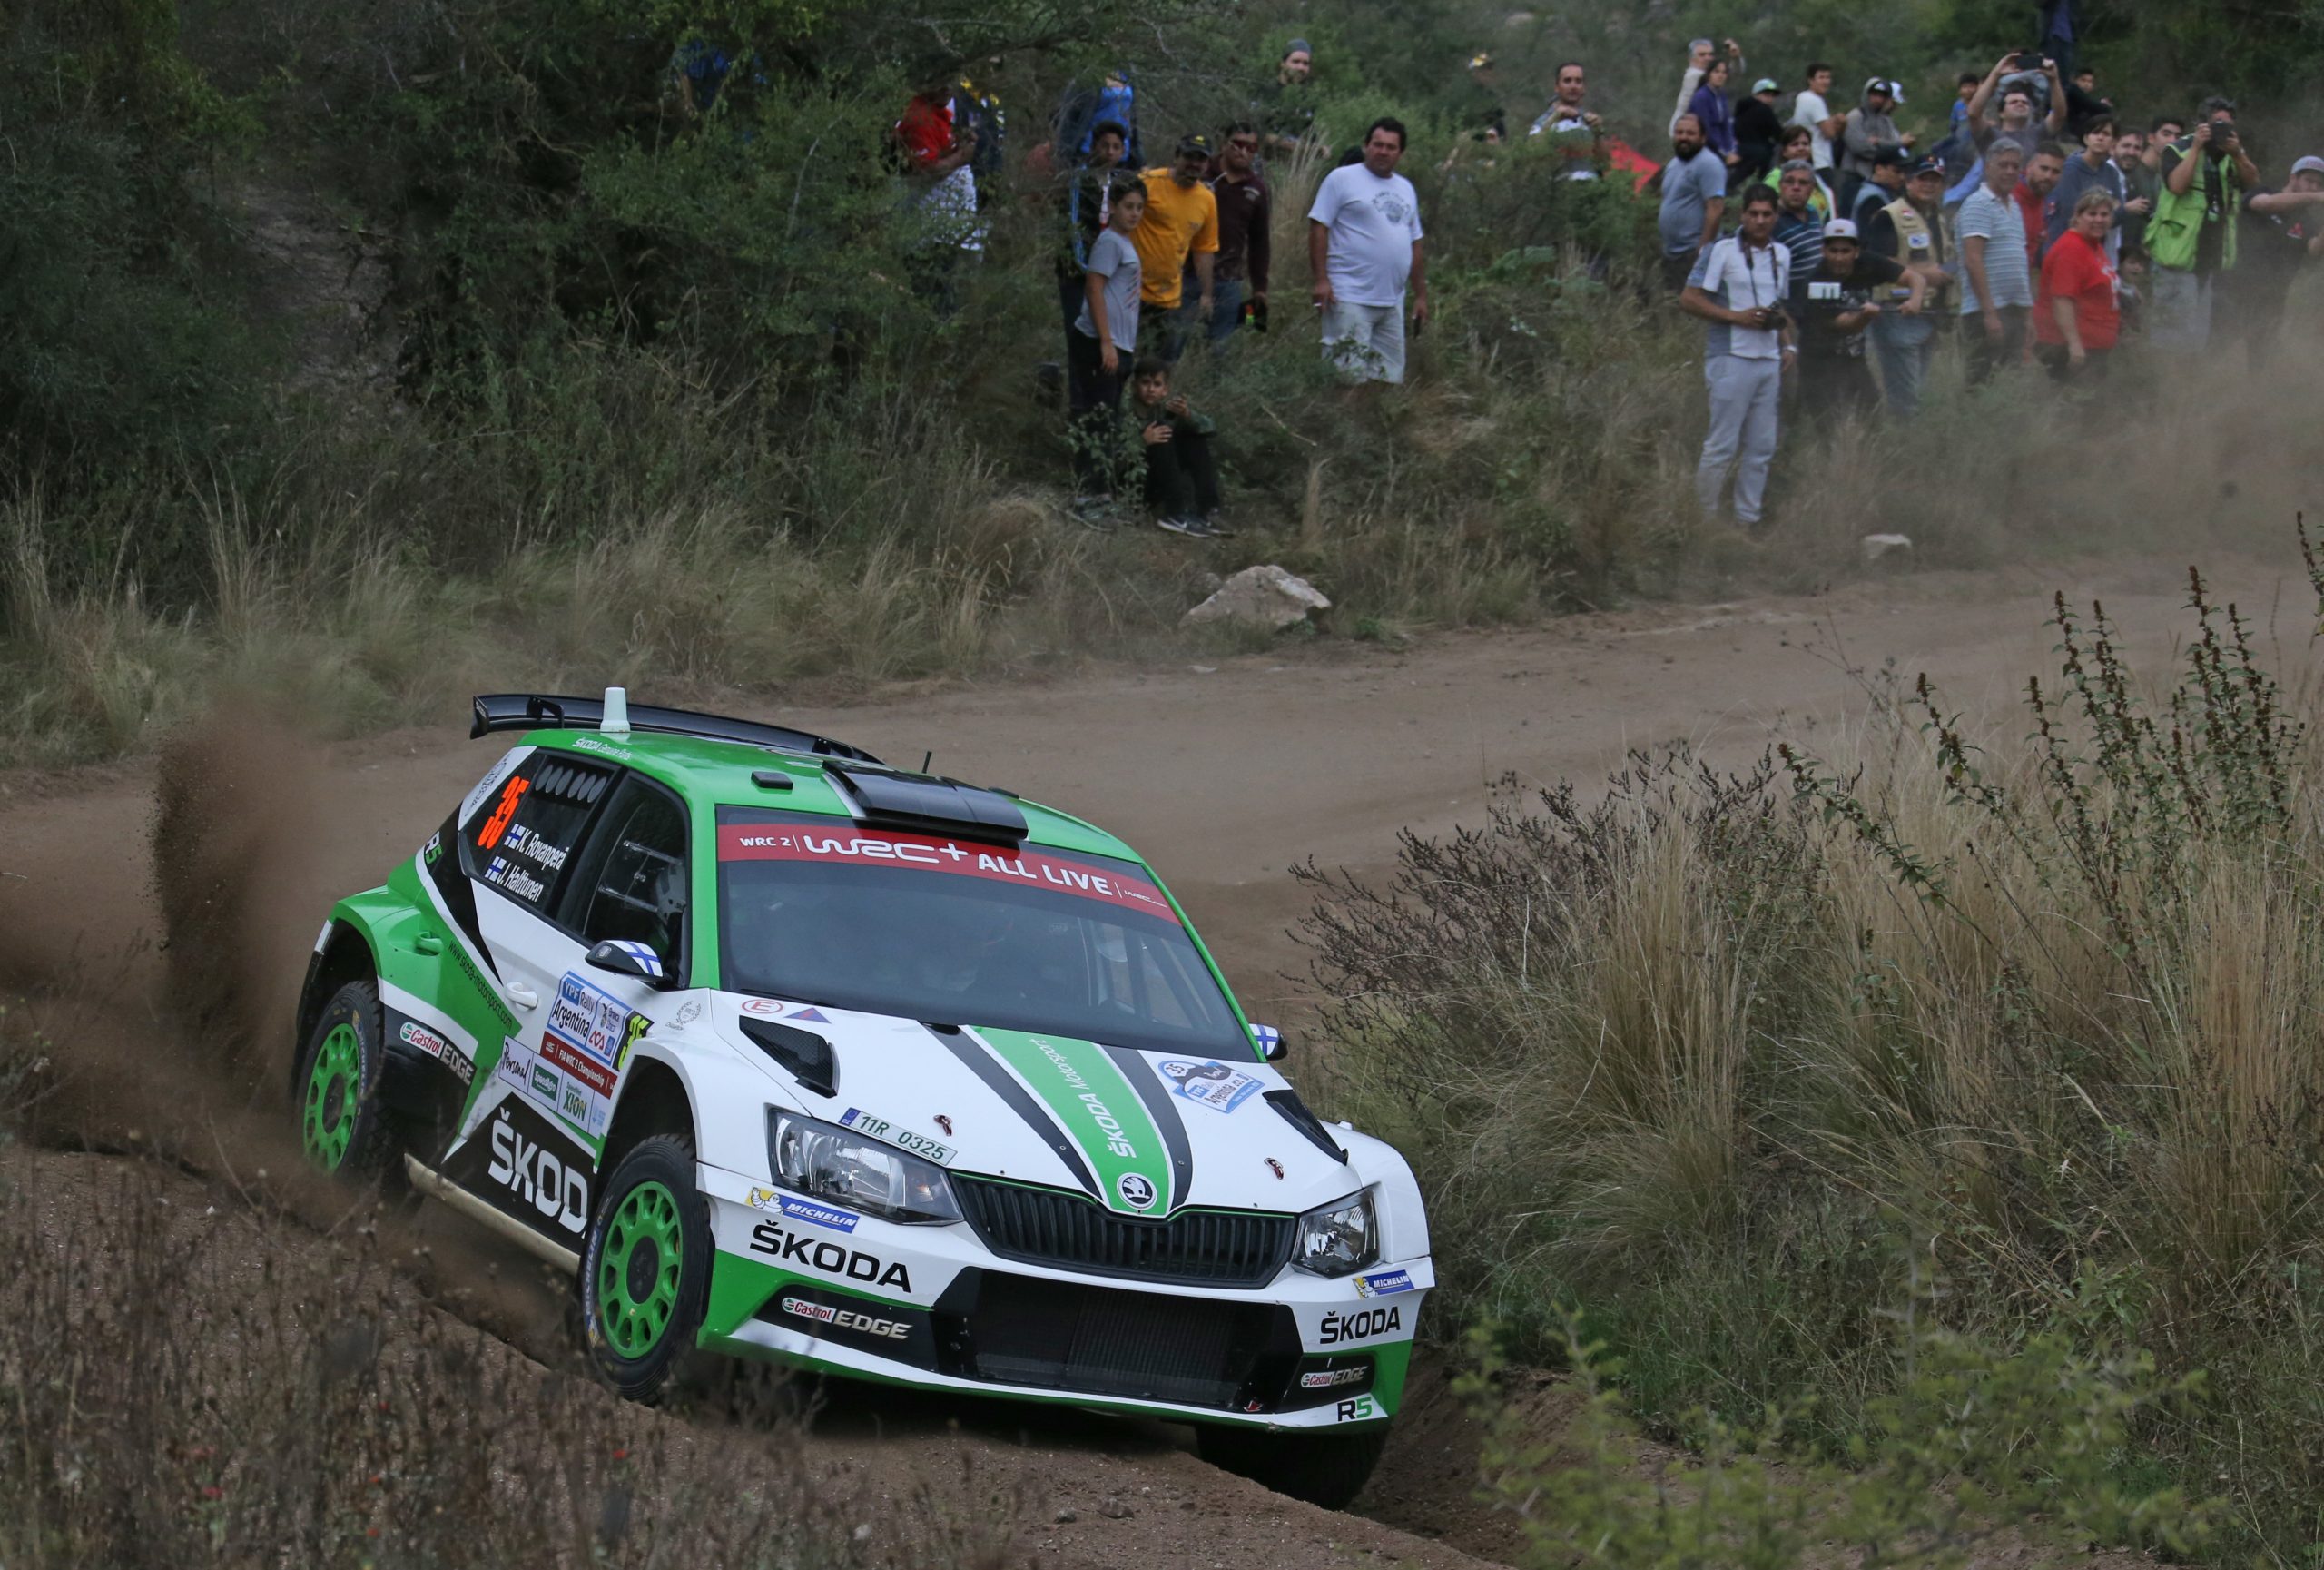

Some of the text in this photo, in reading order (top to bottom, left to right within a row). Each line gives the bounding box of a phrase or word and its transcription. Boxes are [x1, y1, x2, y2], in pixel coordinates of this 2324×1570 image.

[478, 775, 530, 849] 35
[516, 828, 532, 853] K.
[497, 863, 544, 903] J. Halttunen
[739, 837, 778, 848] WRC
[780, 836, 792, 847] 2
[978, 853, 1038, 880] ALL
[1041, 864, 1113, 896] LIVE
[564, 981, 596, 1015] YPF Rally
[551, 999, 590, 1038] Argentina
[410, 1029, 475, 1086] Castrol EDGE
[1029, 1038, 1137, 1159] ŠKODA Motorsport
[860, 1114, 946, 1160] 11R 0325
[487, 1106, 588, 1239] ŠKOD
[783, 1201, 857, 1228] MICHELIN
[749, 1219, 911, 1294] ŠKODA
[1373, 1274, 1410, 1289] MICHELIN
[793, 1301, 914, 1341] Castrol EDGE
[1319, 1306, 1401, 1345] ŠKODA
[1309, 1366, 1368, 1386] Castrol EDGE
[1337, 1397, 1374, 1422] R5
